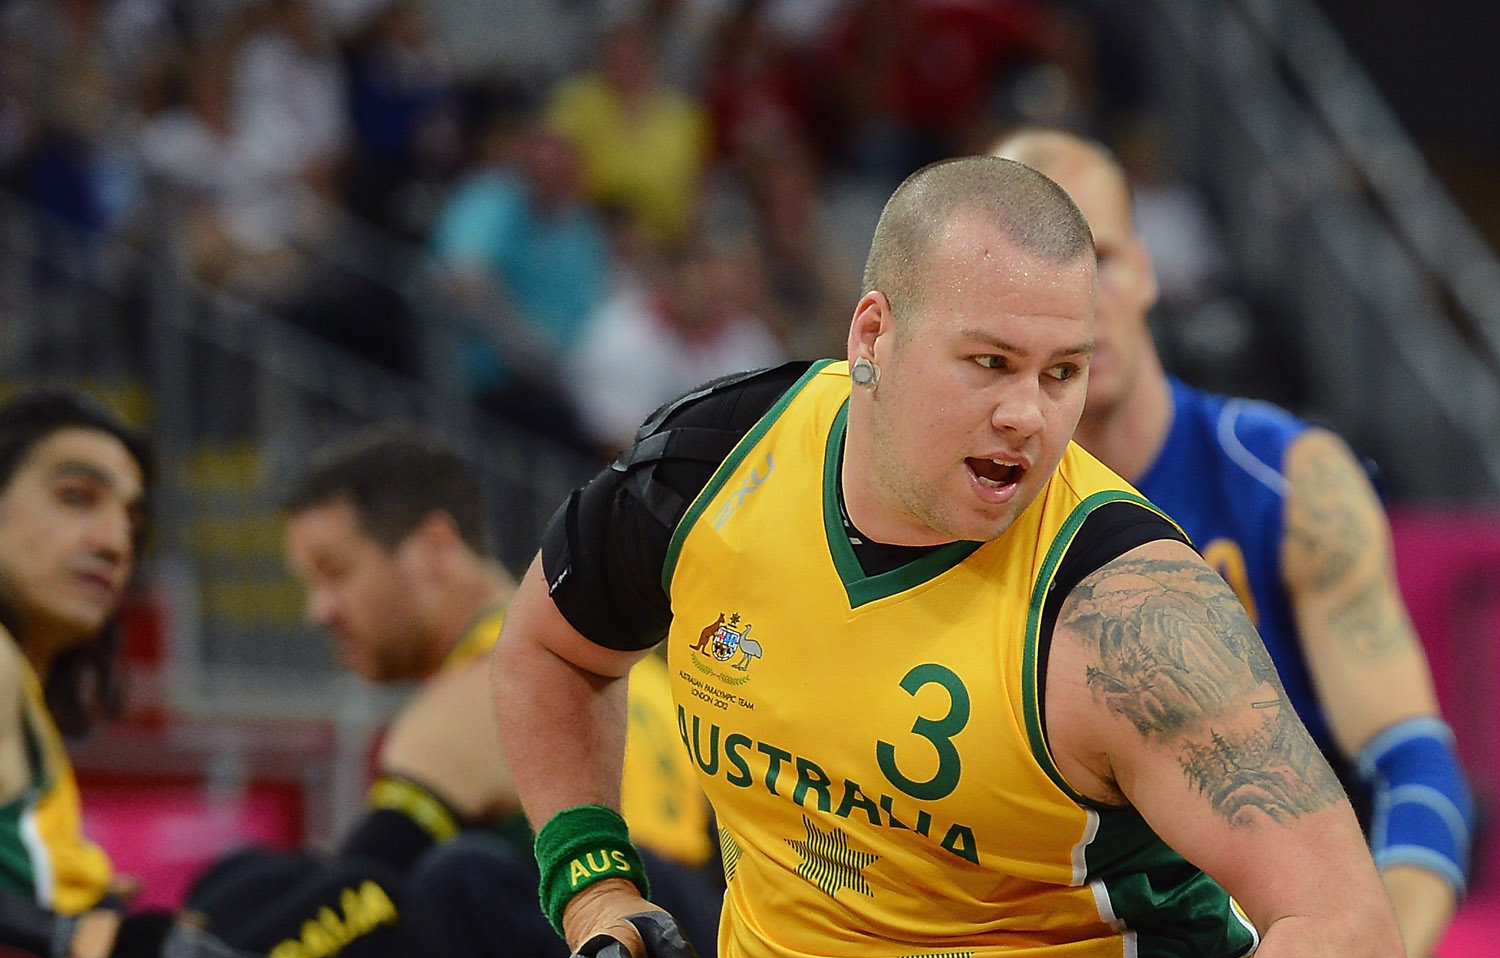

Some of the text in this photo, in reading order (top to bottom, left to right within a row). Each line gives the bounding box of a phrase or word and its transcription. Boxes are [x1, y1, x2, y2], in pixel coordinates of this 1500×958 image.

[691, 687, 729, 711] LONDON 2012
[704, 683, 737, 704] PARALYMPIC
[738, 696, 754, 711] TEAM
[876, 662, 971, 801] 3
[677, 703, 981, 866] AUSTRALIA
[569, 849, 632, 888] AUS
